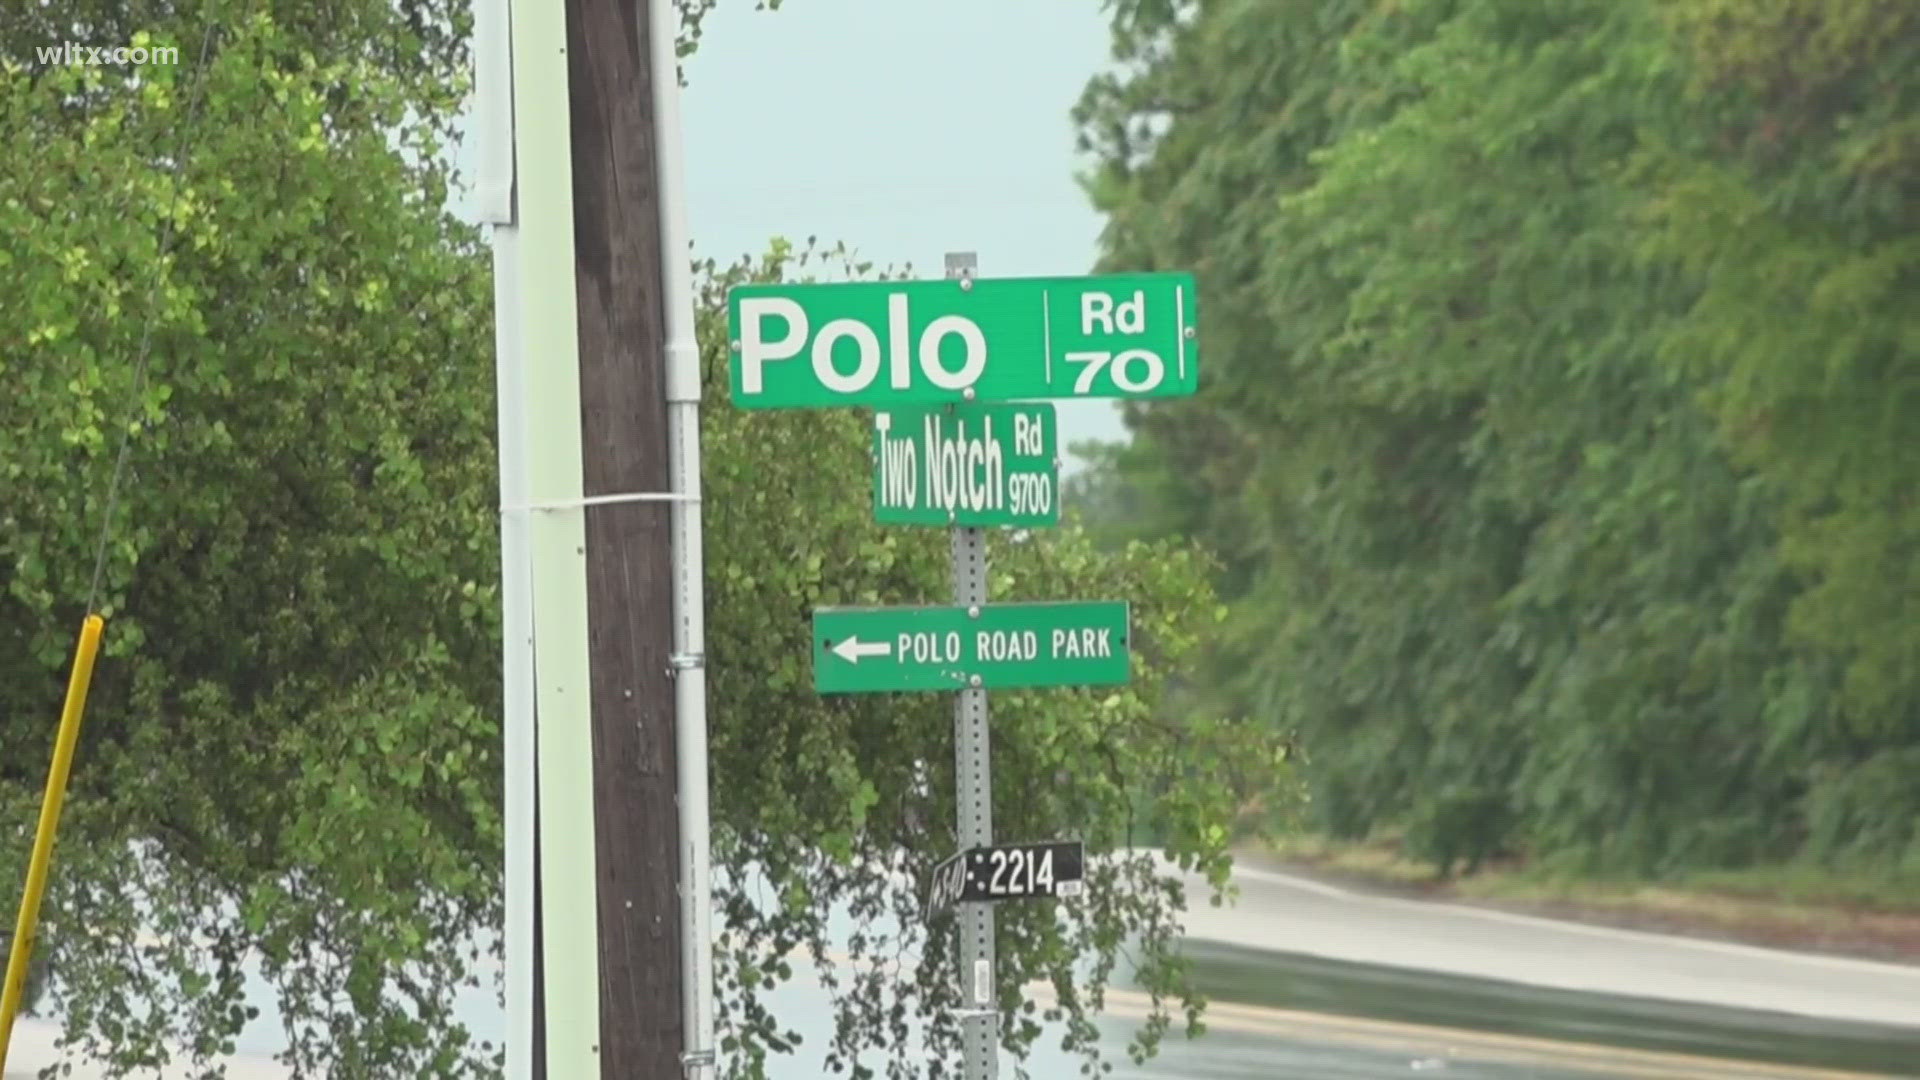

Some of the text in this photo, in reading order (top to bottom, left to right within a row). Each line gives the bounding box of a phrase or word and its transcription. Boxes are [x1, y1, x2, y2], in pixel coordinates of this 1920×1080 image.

[739, 290, 1145, 394] Polo Rd
[1065, 349, 1164, 394] 70
[876, 412, 1043, 512] Two Notch Rd
[1009, 472, 1051, 515] 9700
[898, 628, 1111, 663] POLO ROAD PARK
[989, 849, 1054, 894] 2214
